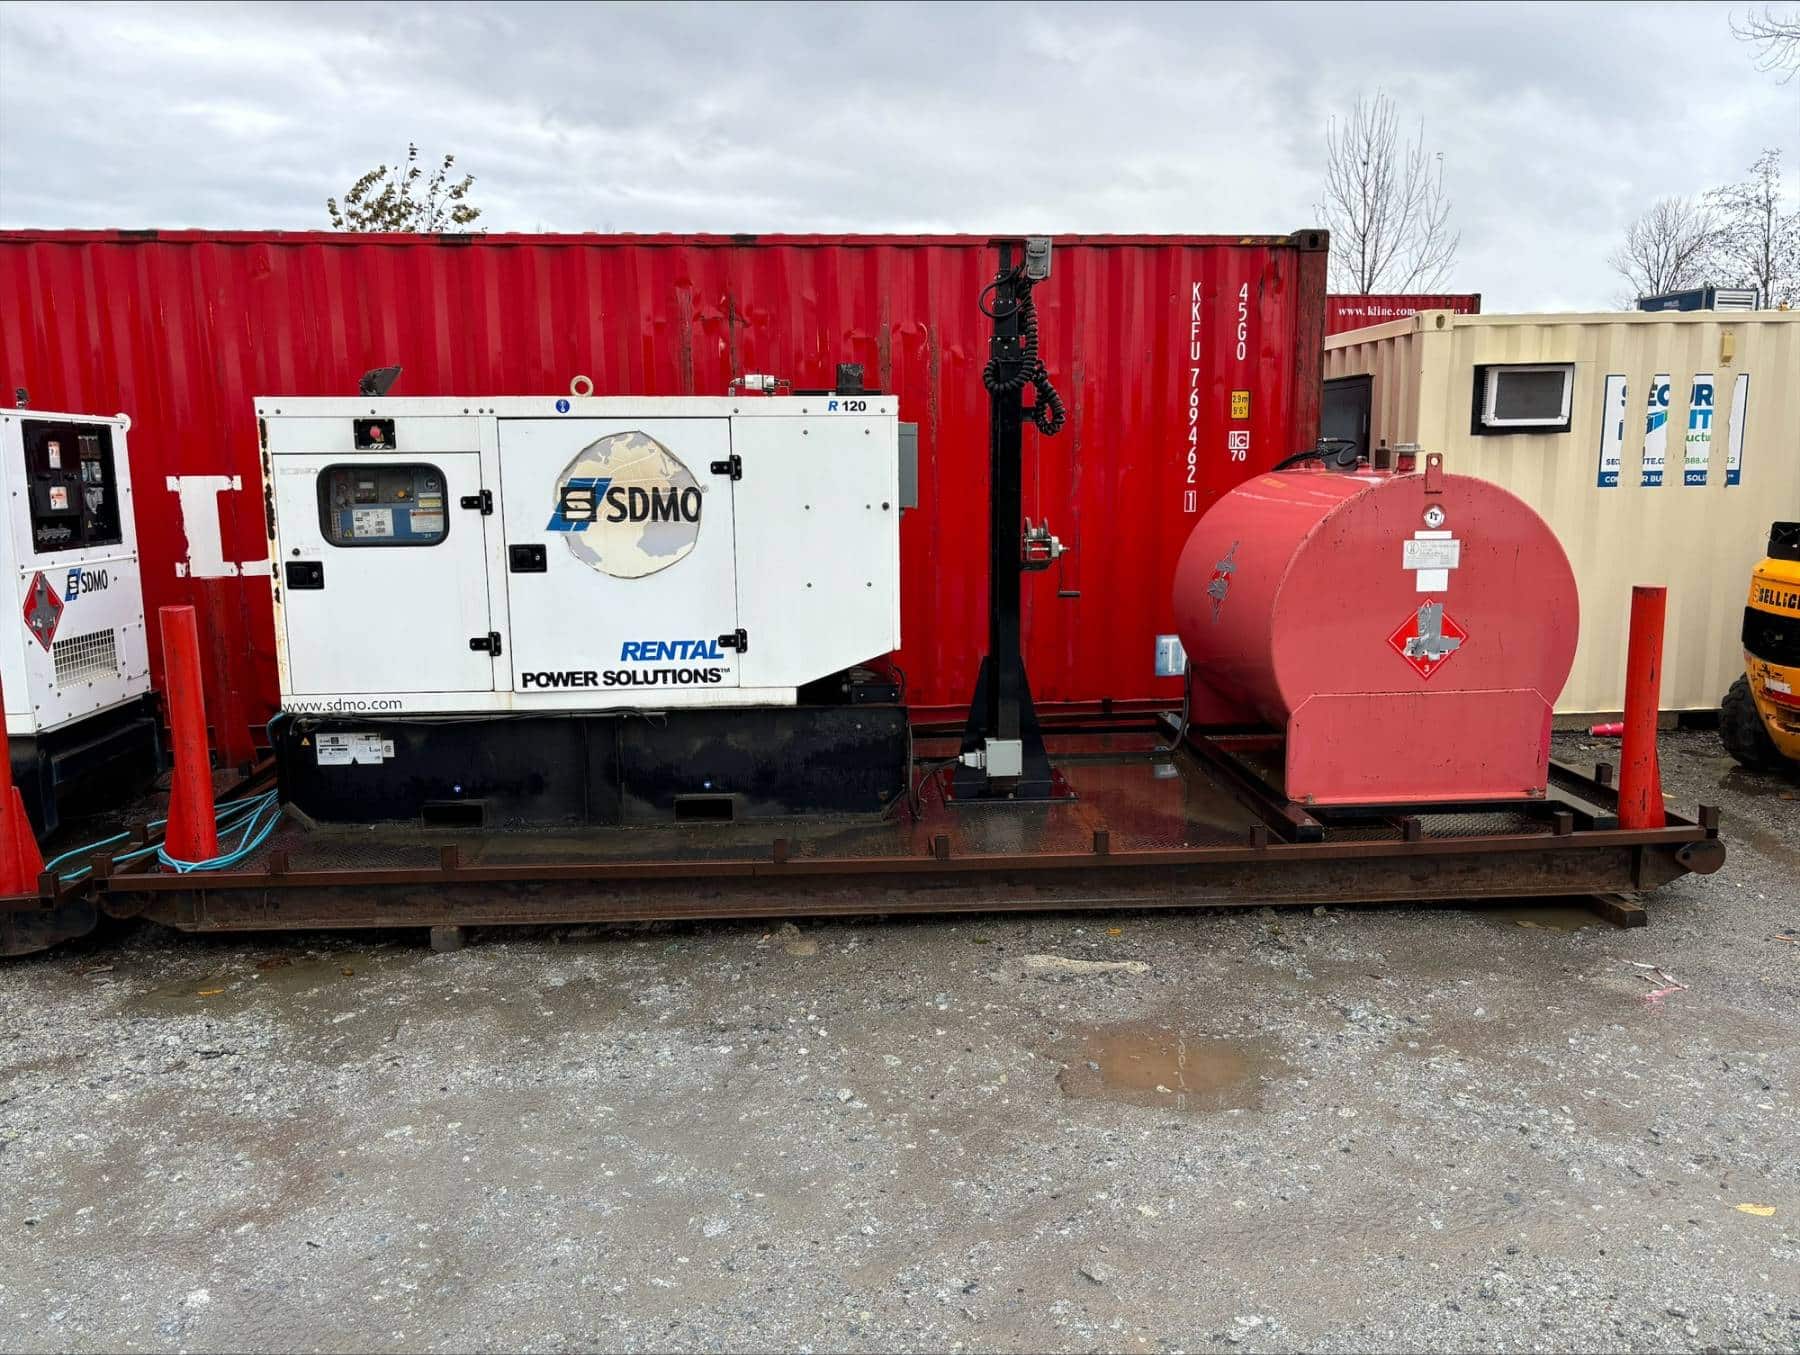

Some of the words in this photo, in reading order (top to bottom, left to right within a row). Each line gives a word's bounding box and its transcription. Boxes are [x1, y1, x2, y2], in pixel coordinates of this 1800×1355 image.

[1190, 282, 1202, 361] KKFU
[828, 401, 838, 411] R
[842, 400, 867, 412] 120
[1186, 368, 1200, 484] 769462
[1230, 450, 1246, 462] 70
[606, 486, 702, 523] SDMO
[81, 570, 108, 594] SDMO
[621, 639, 724, 662] RENTAL
[522, 671, 598, 688] POWER
[283, 698, 402, 712] www.sdmo.com
